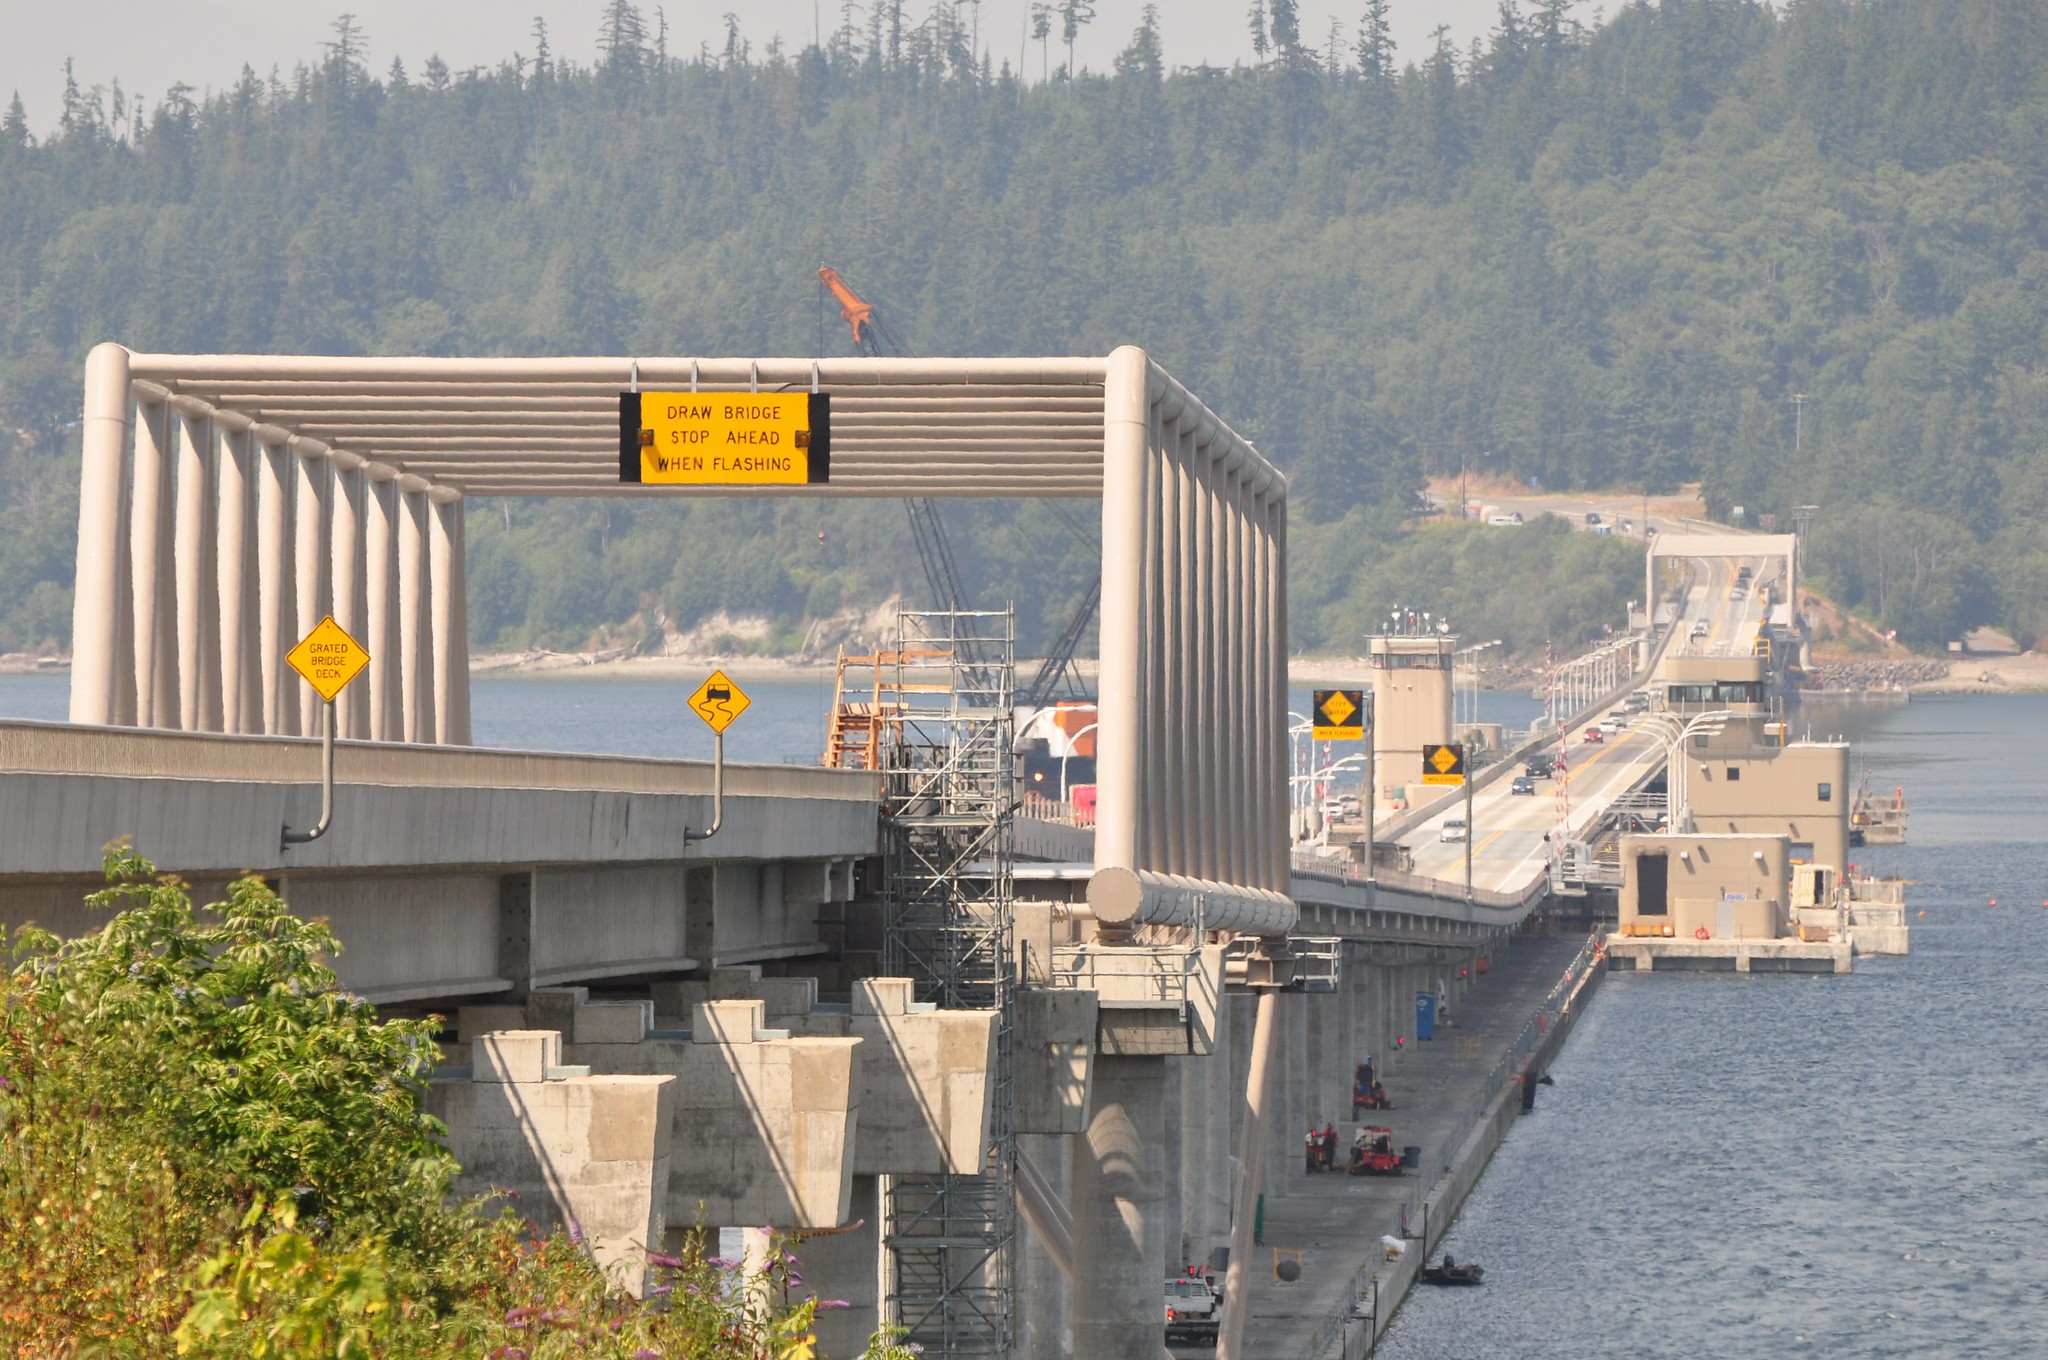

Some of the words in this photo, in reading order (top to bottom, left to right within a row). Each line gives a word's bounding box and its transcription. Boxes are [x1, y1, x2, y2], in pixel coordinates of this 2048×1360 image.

[667, 406, 712, 419] DRAW
[724, 406, 781, 419] BRIDGE
[671, 430, 710, 444] STOP
[726, 431, 780, 445] AHEAD
[658, 457, 703, 471] WHEN
[713, 457, 791, 471] FLASHING
[309, 643, 348, 653] GRATED
[311, 656, 346, 665] BRIDGE
[316, 669, 341, 678] DECK
